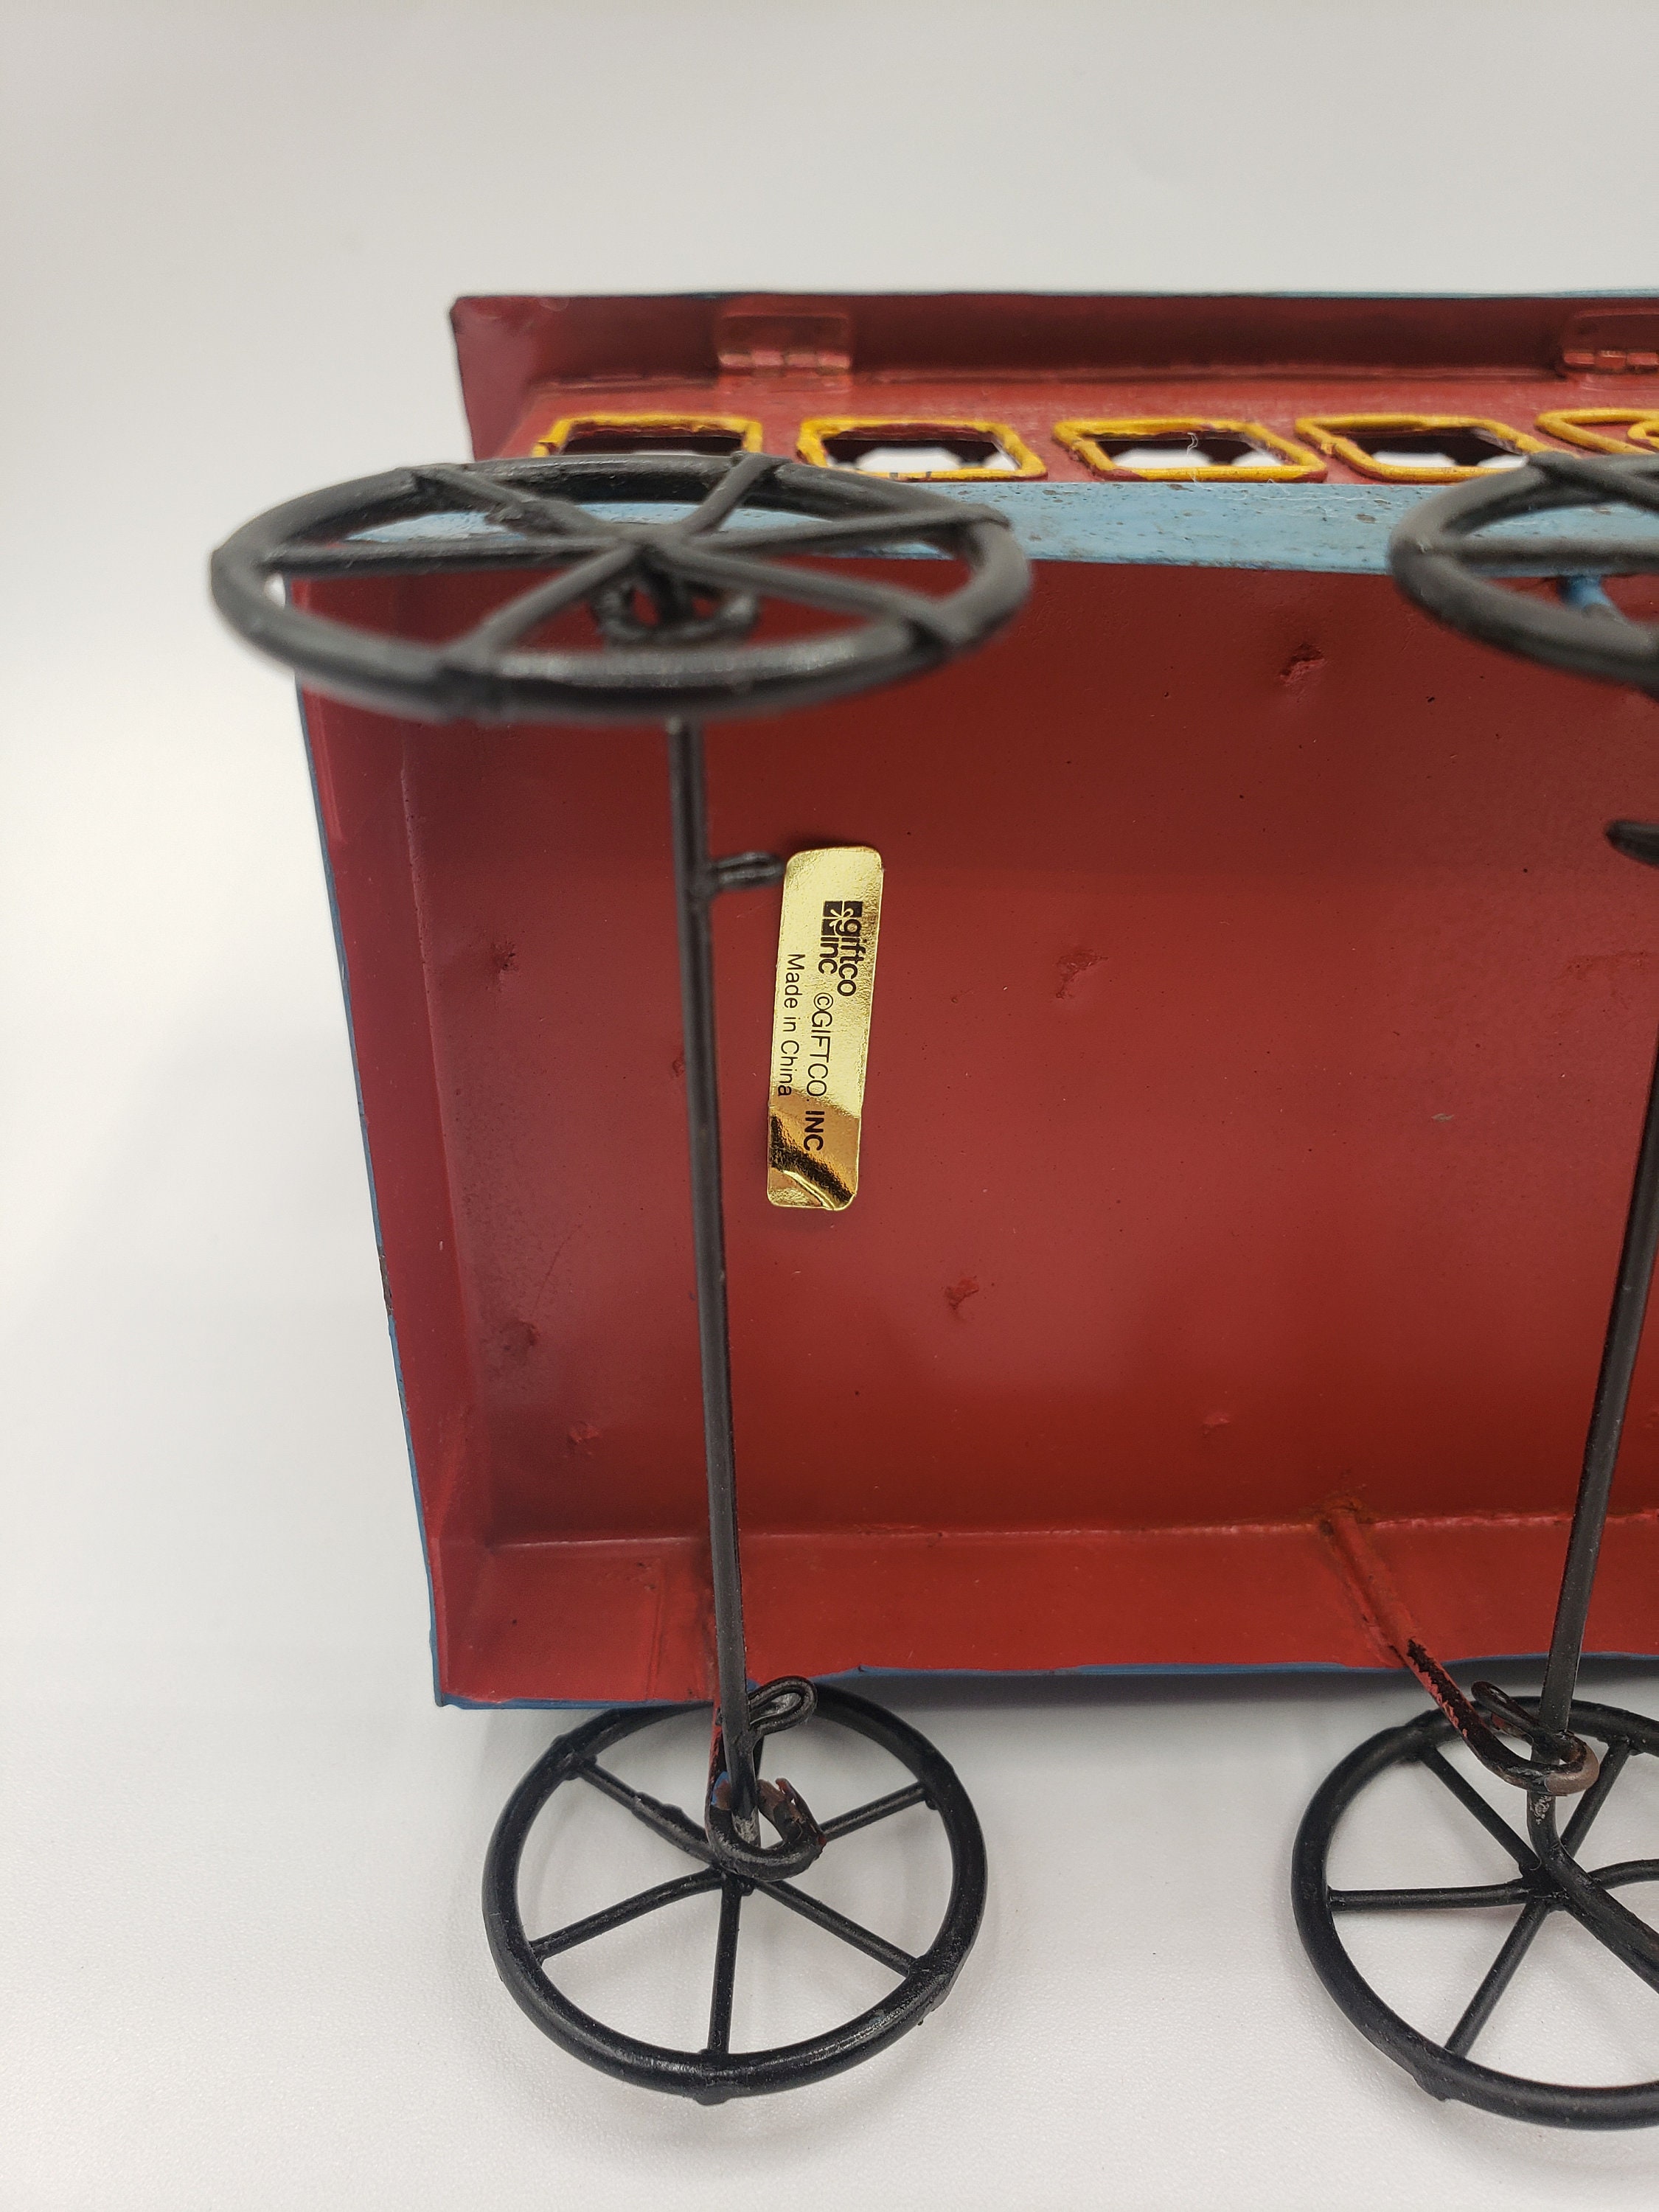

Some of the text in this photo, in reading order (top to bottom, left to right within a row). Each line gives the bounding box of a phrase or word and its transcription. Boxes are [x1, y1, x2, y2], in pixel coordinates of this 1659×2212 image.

[835, 919, 866, 996] giftco
[777, 953, 806, 1096] Made in China
[803, 1110, 825, 1151] INC
